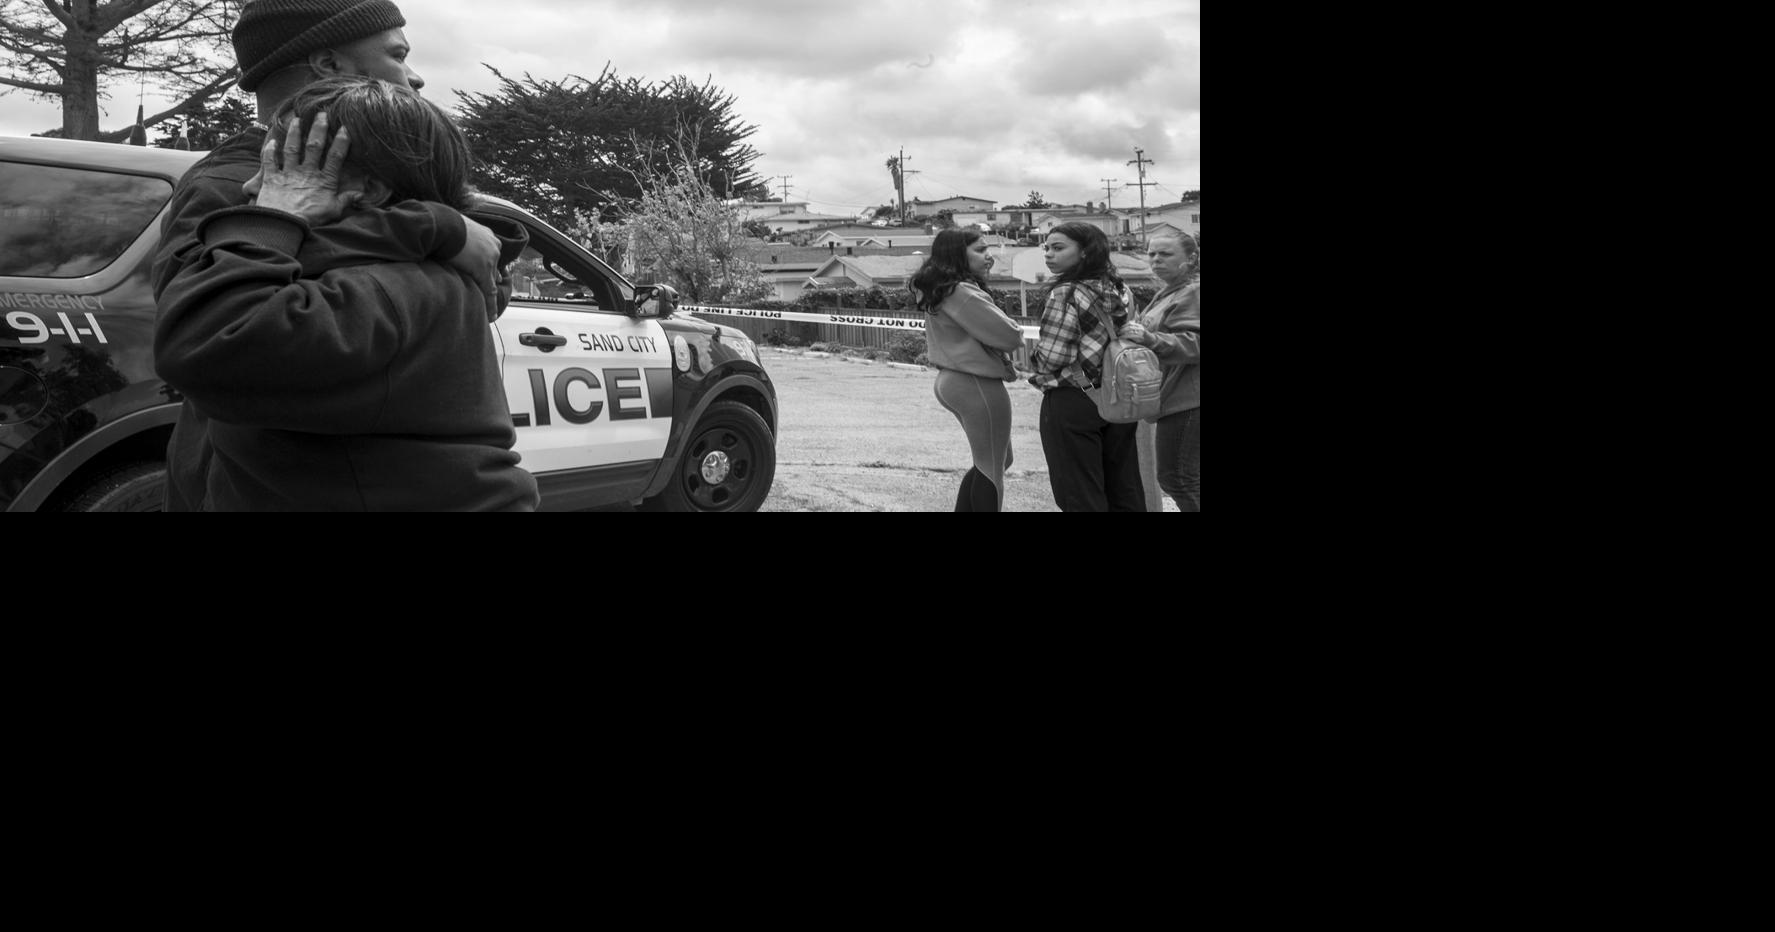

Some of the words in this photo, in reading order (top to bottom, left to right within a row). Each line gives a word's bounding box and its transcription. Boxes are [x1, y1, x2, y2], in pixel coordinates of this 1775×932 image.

[6, 311, 108, 344] 9-1-1
[578, 333, 624, 351] SAND
[628, 335, 657, 353] CITY
